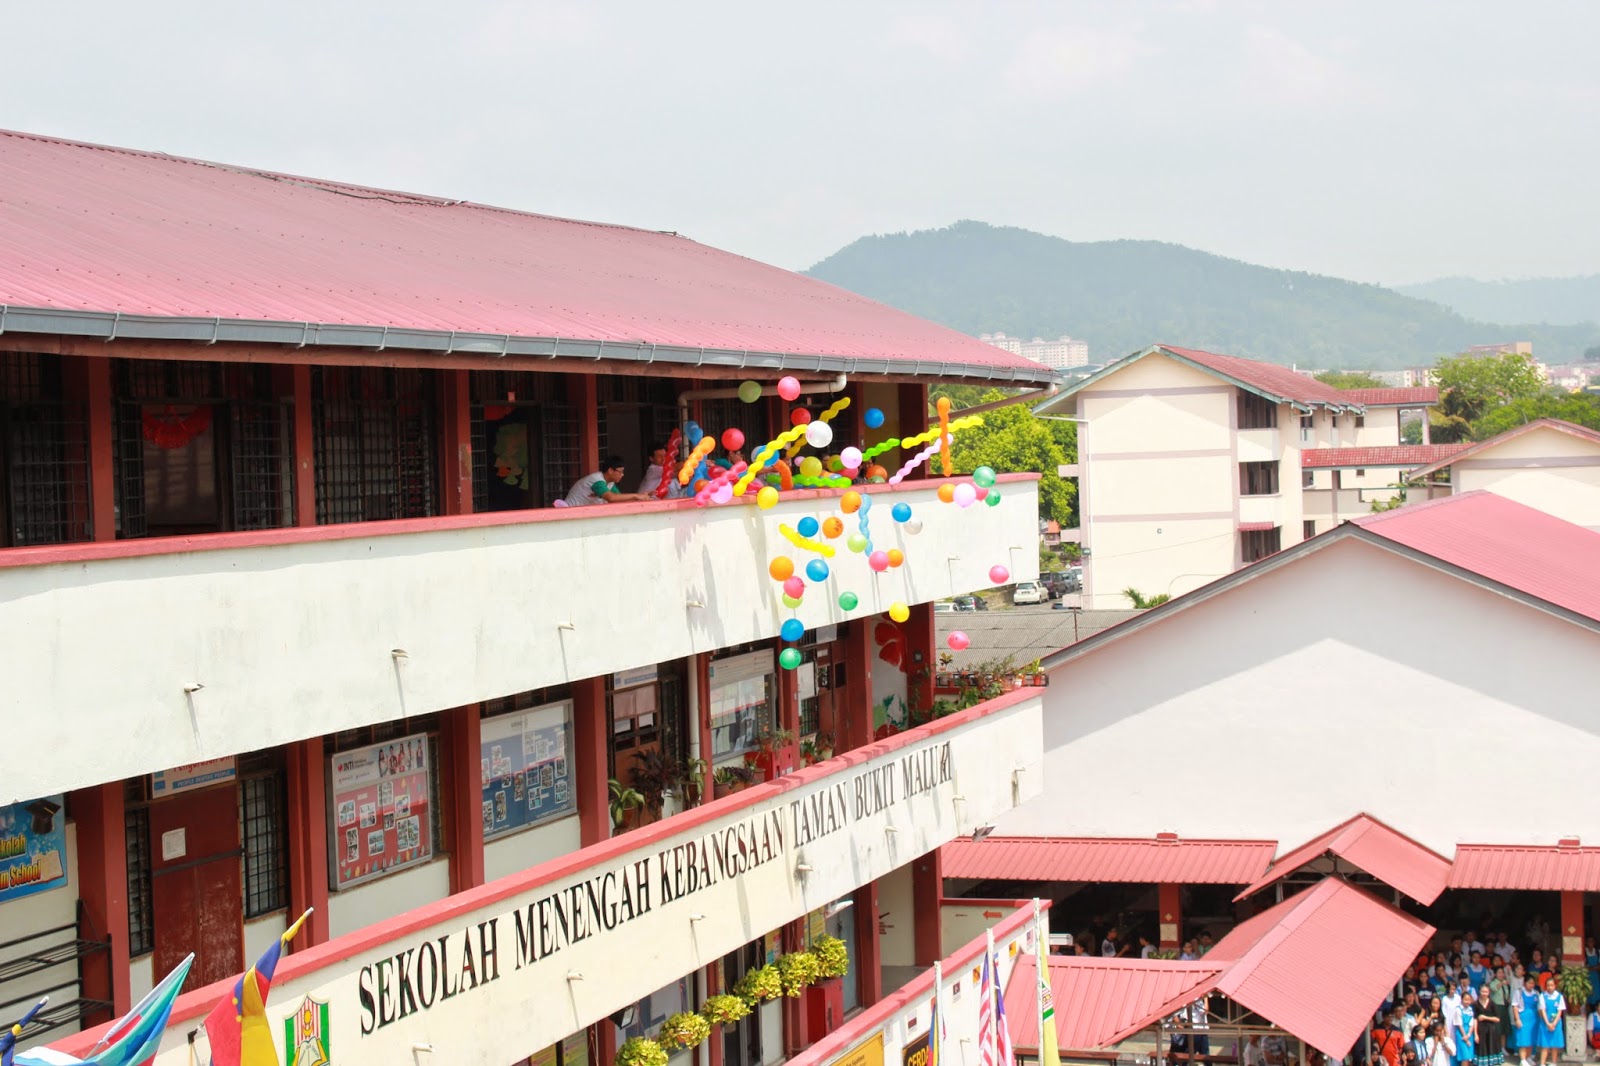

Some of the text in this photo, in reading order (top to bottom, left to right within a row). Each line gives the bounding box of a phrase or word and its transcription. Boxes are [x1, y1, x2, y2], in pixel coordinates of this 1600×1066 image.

[10, 859, 41, 887] School
[358, 917, 500, 1038] SEKOLAH
[513, 857, 651, 970] MENENGAH
[658, 807, 784, 906] KEBANGSAAN
[790, 781, 848, 849] TAMAN
[855, 761, 895, 822] BUKIT
